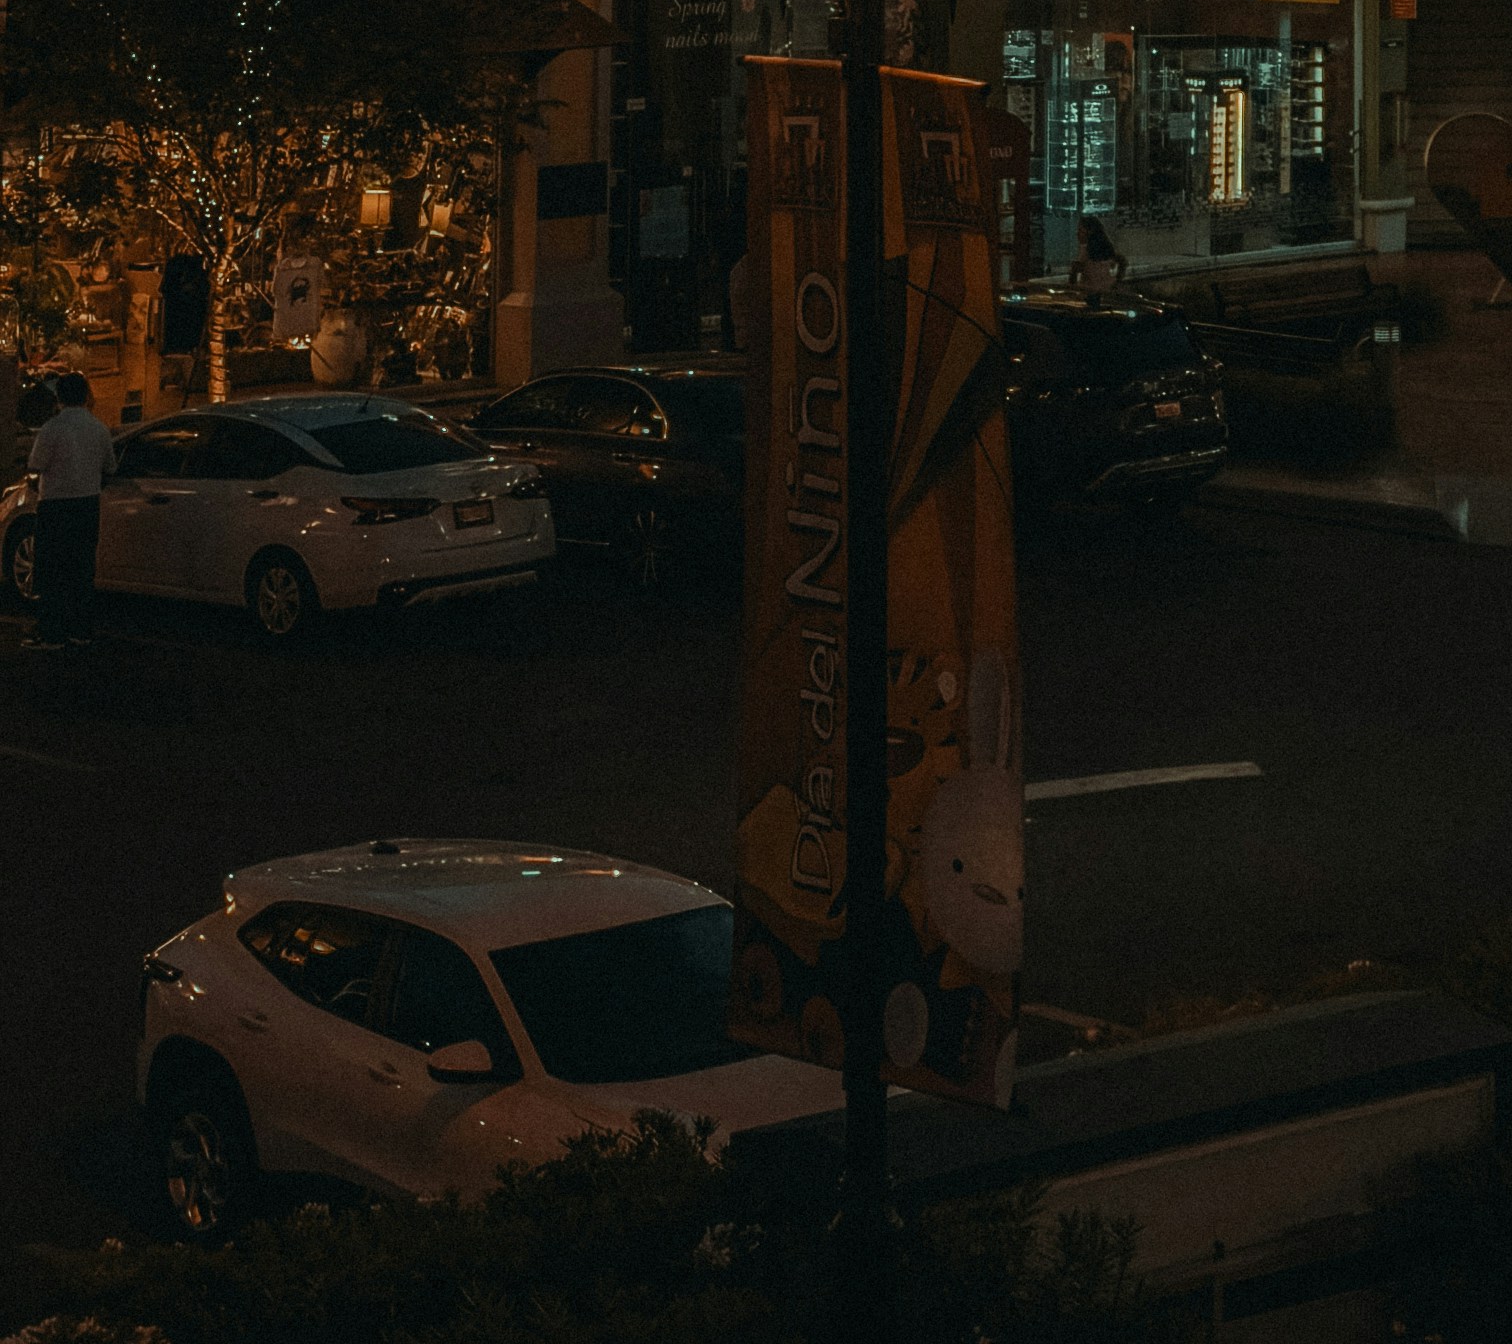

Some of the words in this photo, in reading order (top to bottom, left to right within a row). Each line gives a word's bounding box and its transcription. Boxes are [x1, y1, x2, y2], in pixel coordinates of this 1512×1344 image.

[666, 23, 708, 49] nails
[784, 270, 843, 604] Niño
[800, 627, 837, 741] del
